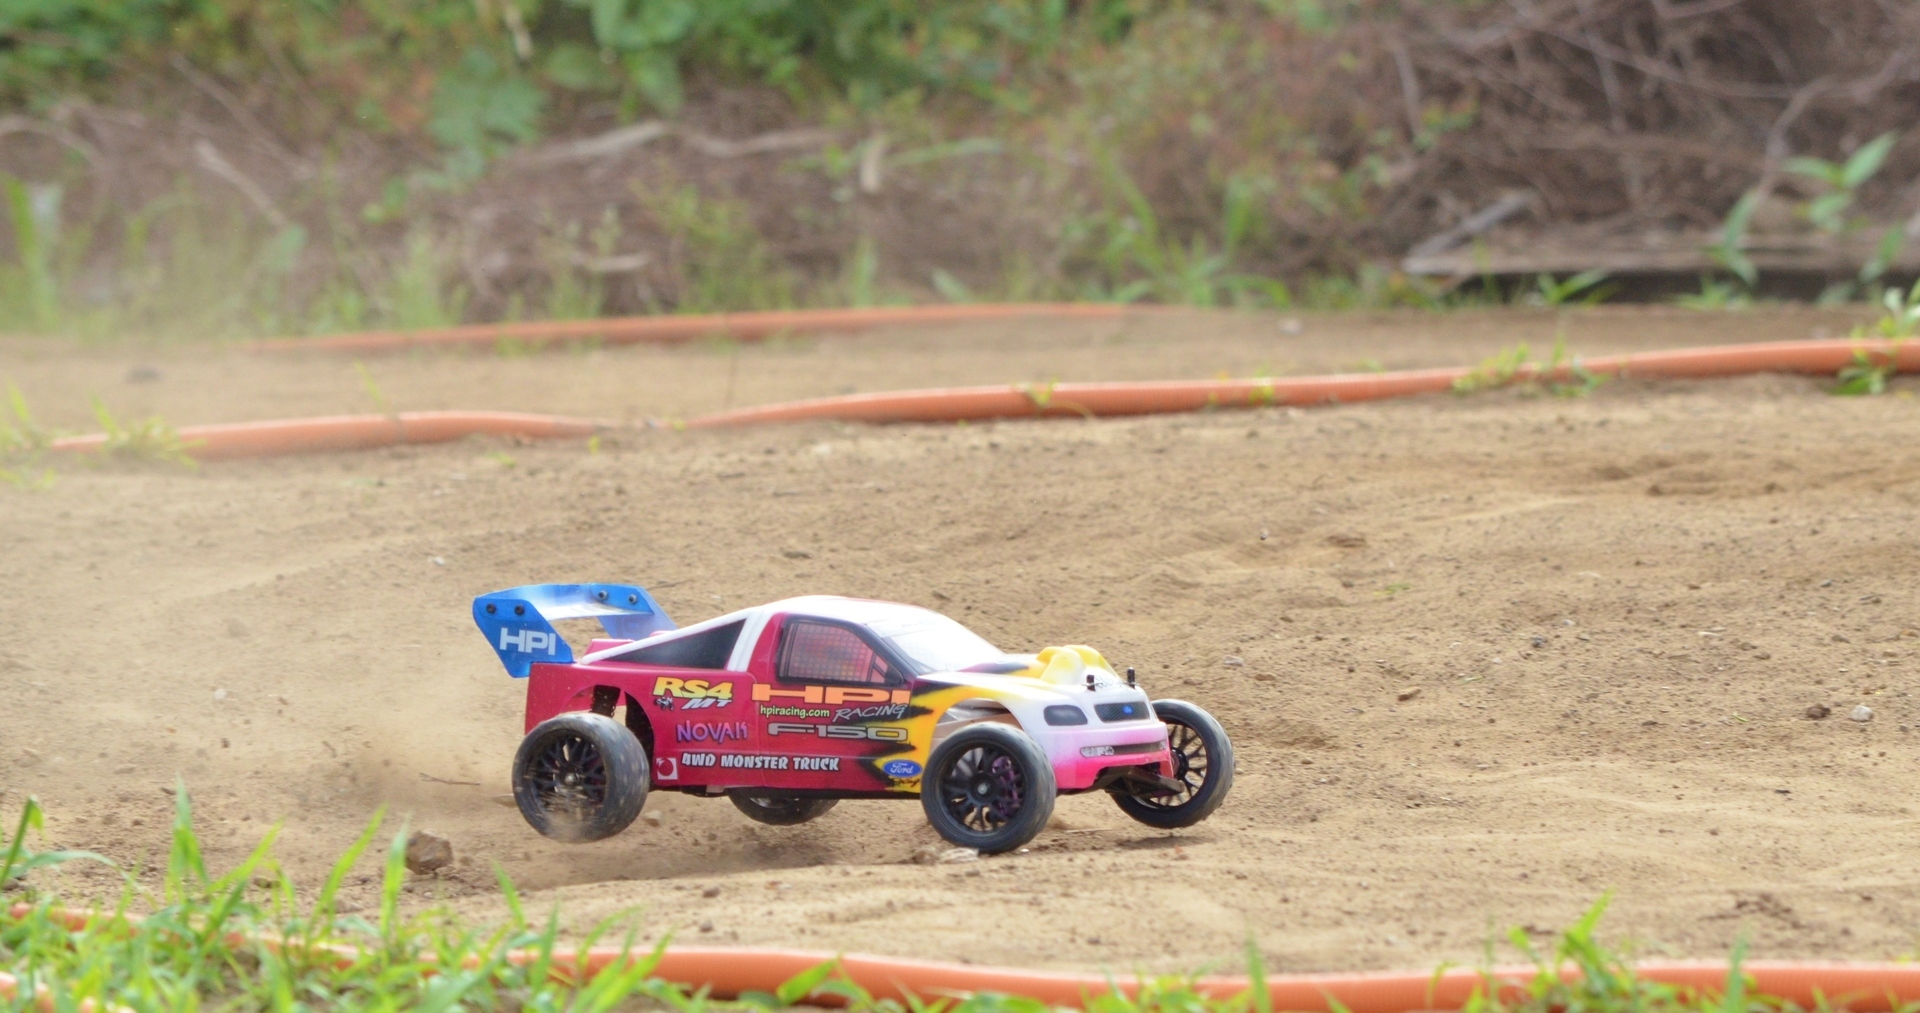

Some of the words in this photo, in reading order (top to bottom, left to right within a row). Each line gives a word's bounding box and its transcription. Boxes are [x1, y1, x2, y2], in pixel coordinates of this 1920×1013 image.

[500, 627, 556, 656] HPI
[652, 676, 733, 699] RS4
[751, 683, 912, 705] HPI
[681, 698, 732, 710] MT
[760, 705, 830, 719] hpiracing.com
[832, 704, 908, 722] RACING
[676, 720, 748, 744] NOVAK
[768, 722, 908, 741] F-150
[681, 752, 716, 767] 4WD
[721, 754, 788, 769] MONSTER
[793, 757, 839, 771] TRUCK
[890, 762, 914, 774] Ford
